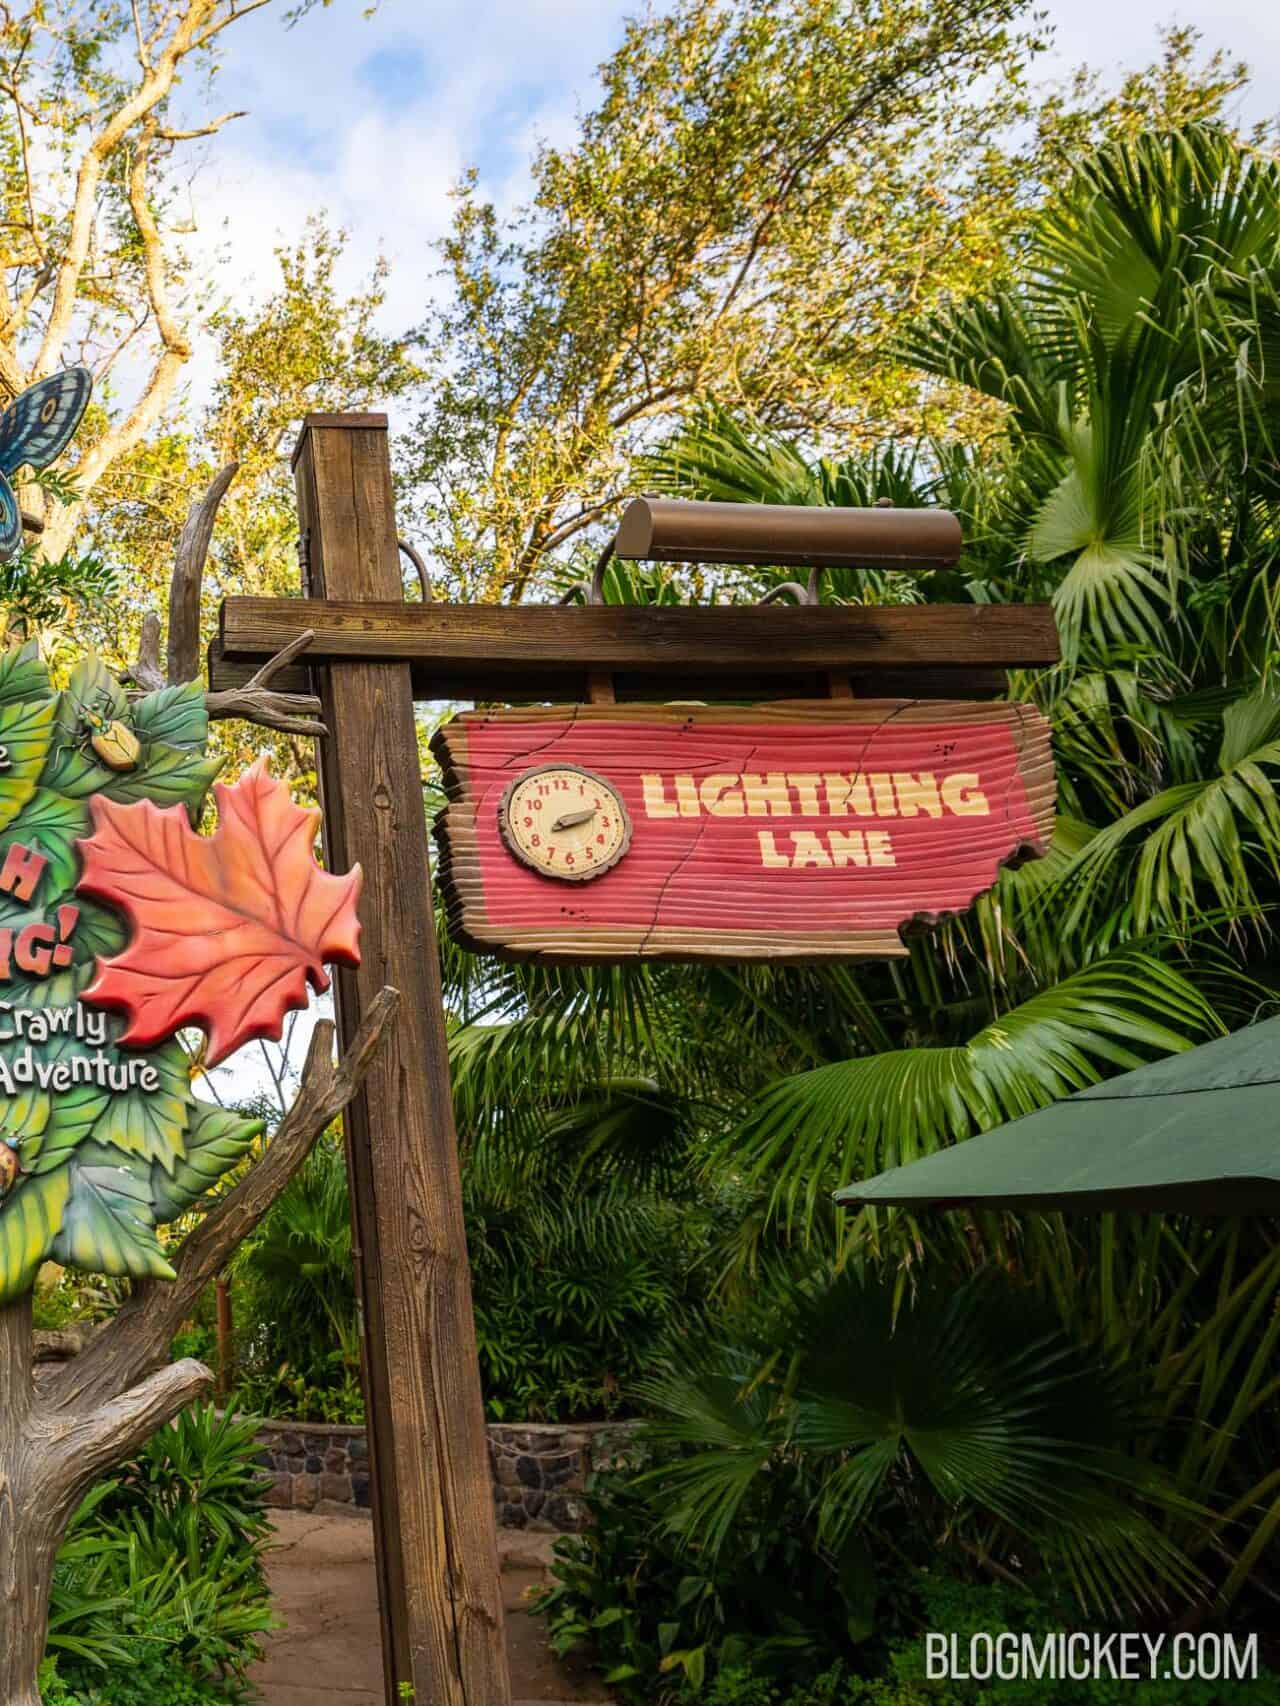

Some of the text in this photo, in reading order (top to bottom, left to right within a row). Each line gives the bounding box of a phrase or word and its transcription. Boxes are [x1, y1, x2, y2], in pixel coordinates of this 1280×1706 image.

[537, 785, 550, 796] 11
[553, 780, 570, 790] 12
[640, 771, 989, 818] LIGHTNING
[526, 799, 542, 810] 10
[594, 799, 602, 810] 2
[523, 816, 532, 827] 9
[601, 816, 610, 827] 3
[531, 834, 540, 847] 8
[596, 834, 605, 845] 4
[547, 847, 556, 859] 7
[586, 847, 593, 859] 5
[758, 830, 897, 868] LANE
[565, 852, 574, 864] 6
